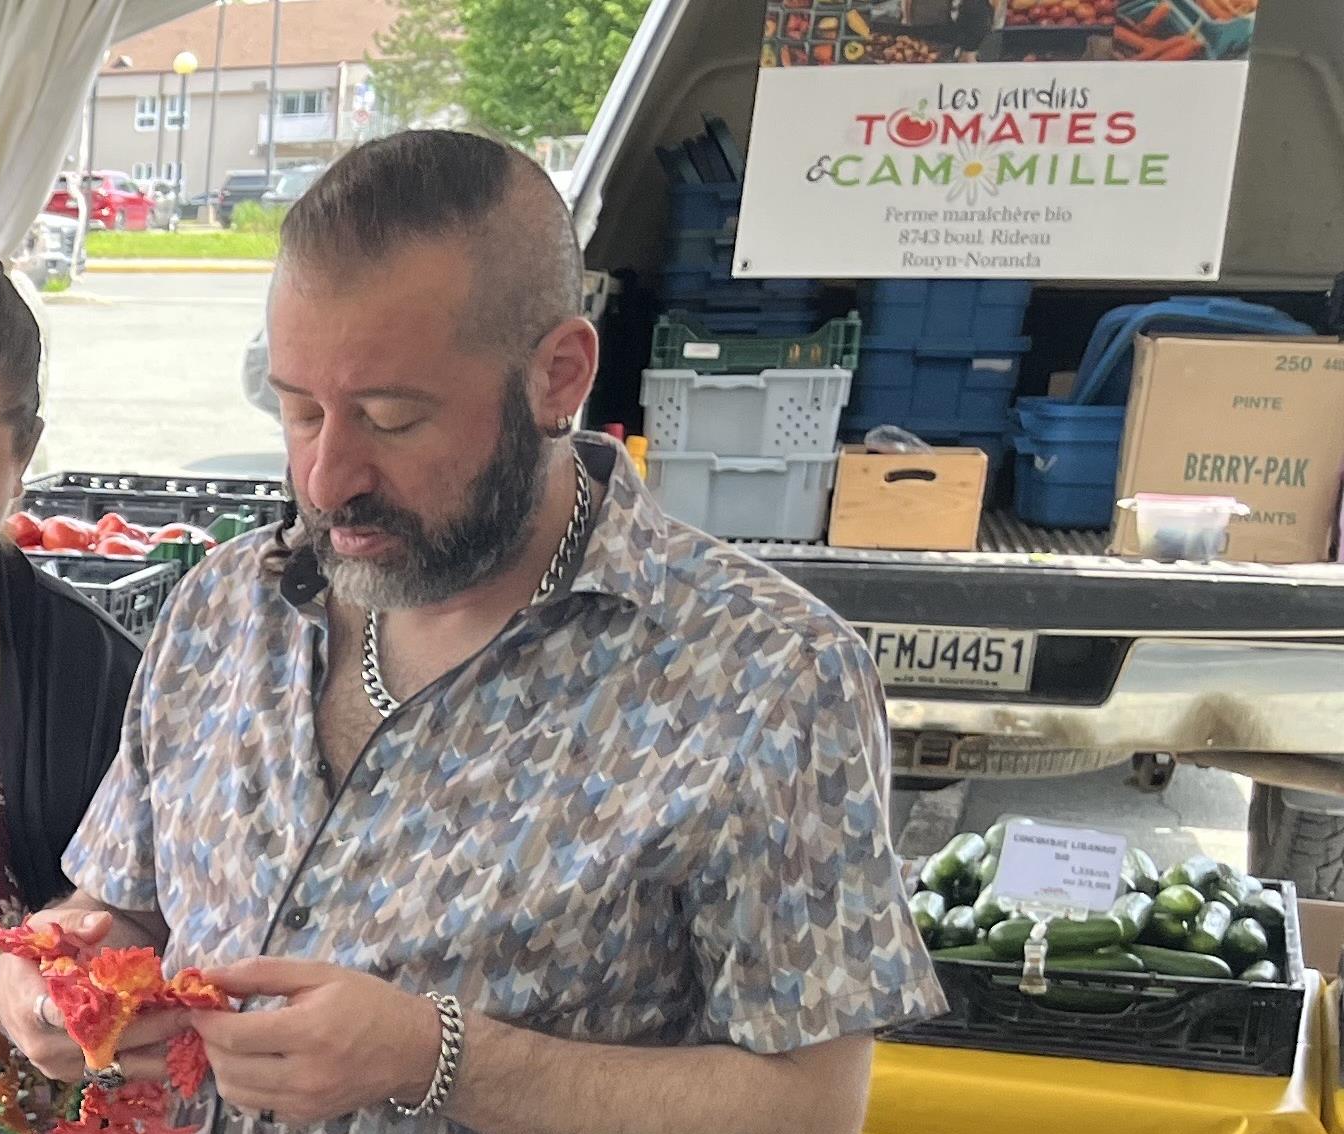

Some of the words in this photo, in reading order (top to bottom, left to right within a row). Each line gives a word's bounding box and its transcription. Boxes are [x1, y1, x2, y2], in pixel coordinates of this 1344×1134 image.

[937, 82, 981, 111] Les
[989, 78, 1090, 121] jardins
[855, 107, 1137, 147] TOMATES
[884, 207, 939, 223] Ferme
[1044, 206, 1073, 223] bio
[898, 229, 941, 246] 8743
[990, 229, 1051, 246] Rideau
[901, 251, 1041, 271] Rouyn-Noranda
[1275, 355, 1313, 372] 250
[1232, 395, 1283, 410] PINTE
[1184, 452, 1311, 487] BERRY-PAK
[875, 632, 1024, 674] FMJ4451
